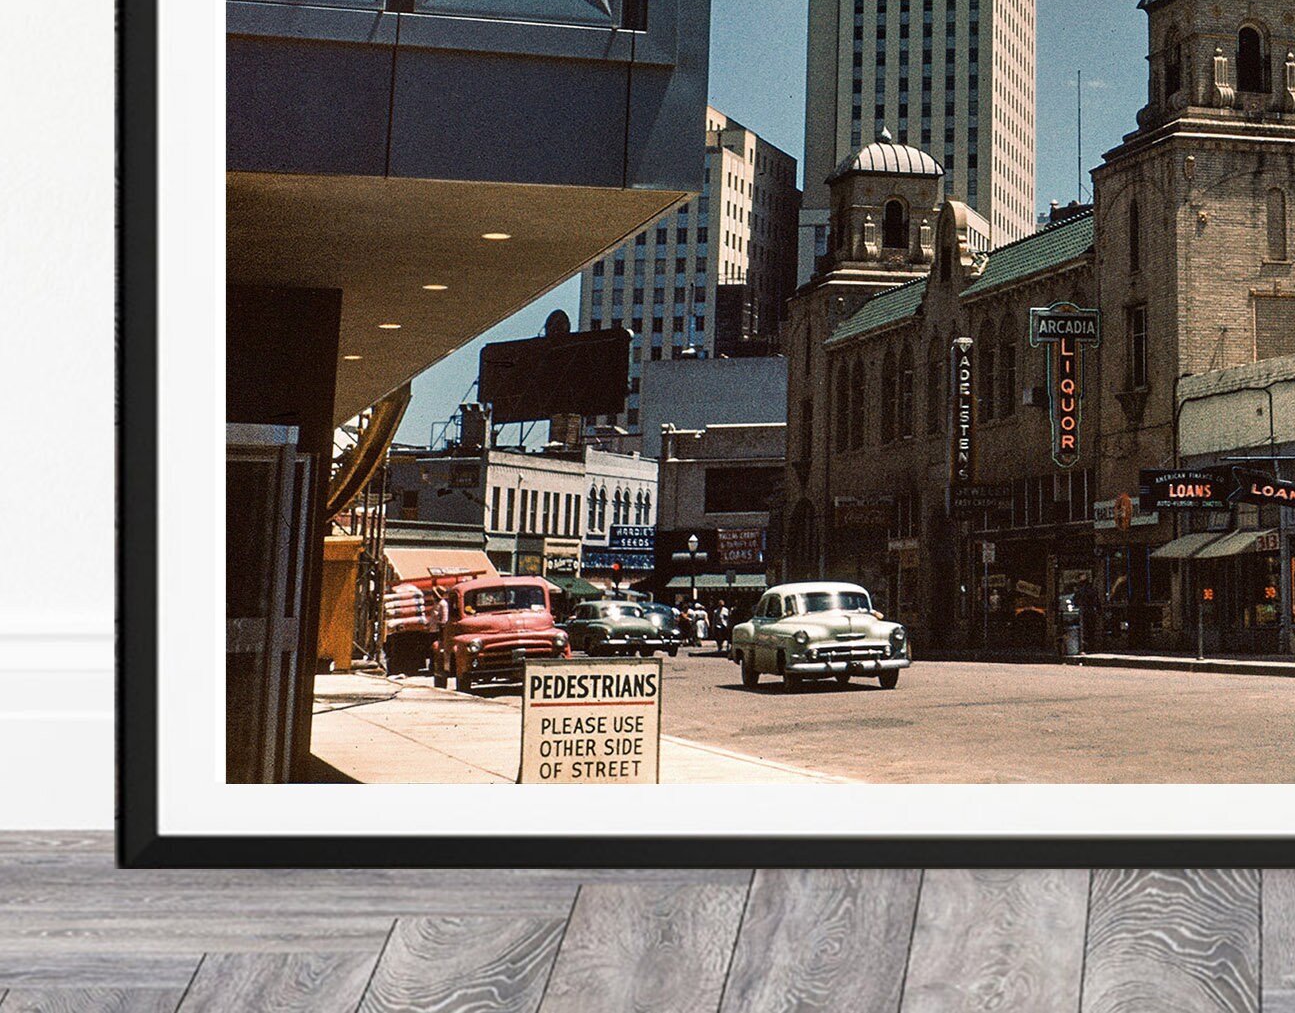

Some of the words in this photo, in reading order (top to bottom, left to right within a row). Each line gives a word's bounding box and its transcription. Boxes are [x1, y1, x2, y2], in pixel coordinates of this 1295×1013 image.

[1039, 319, 1095, 334] ARCADIA
[1061, 337, 1075, 449] LIQUOR
[1155, 473, 1186, 483] AMERICAN
[1169, 483, 1212, 498] LOANS
[616, 528, 655, 537] HARDIE'S
[621, 538, 650, 547] SEEDS
[530, 673, 657, 699] PEDESTRIANS
[541, 717, 607, 735] PLEASE
[613, 716, 644, 733] USE
[540, 739, 597, 757] OTHER
[604, 738, 643, 755] SIDE
[540, 762, 563, 779] OF
[572, 760, 642, 778] STREET
